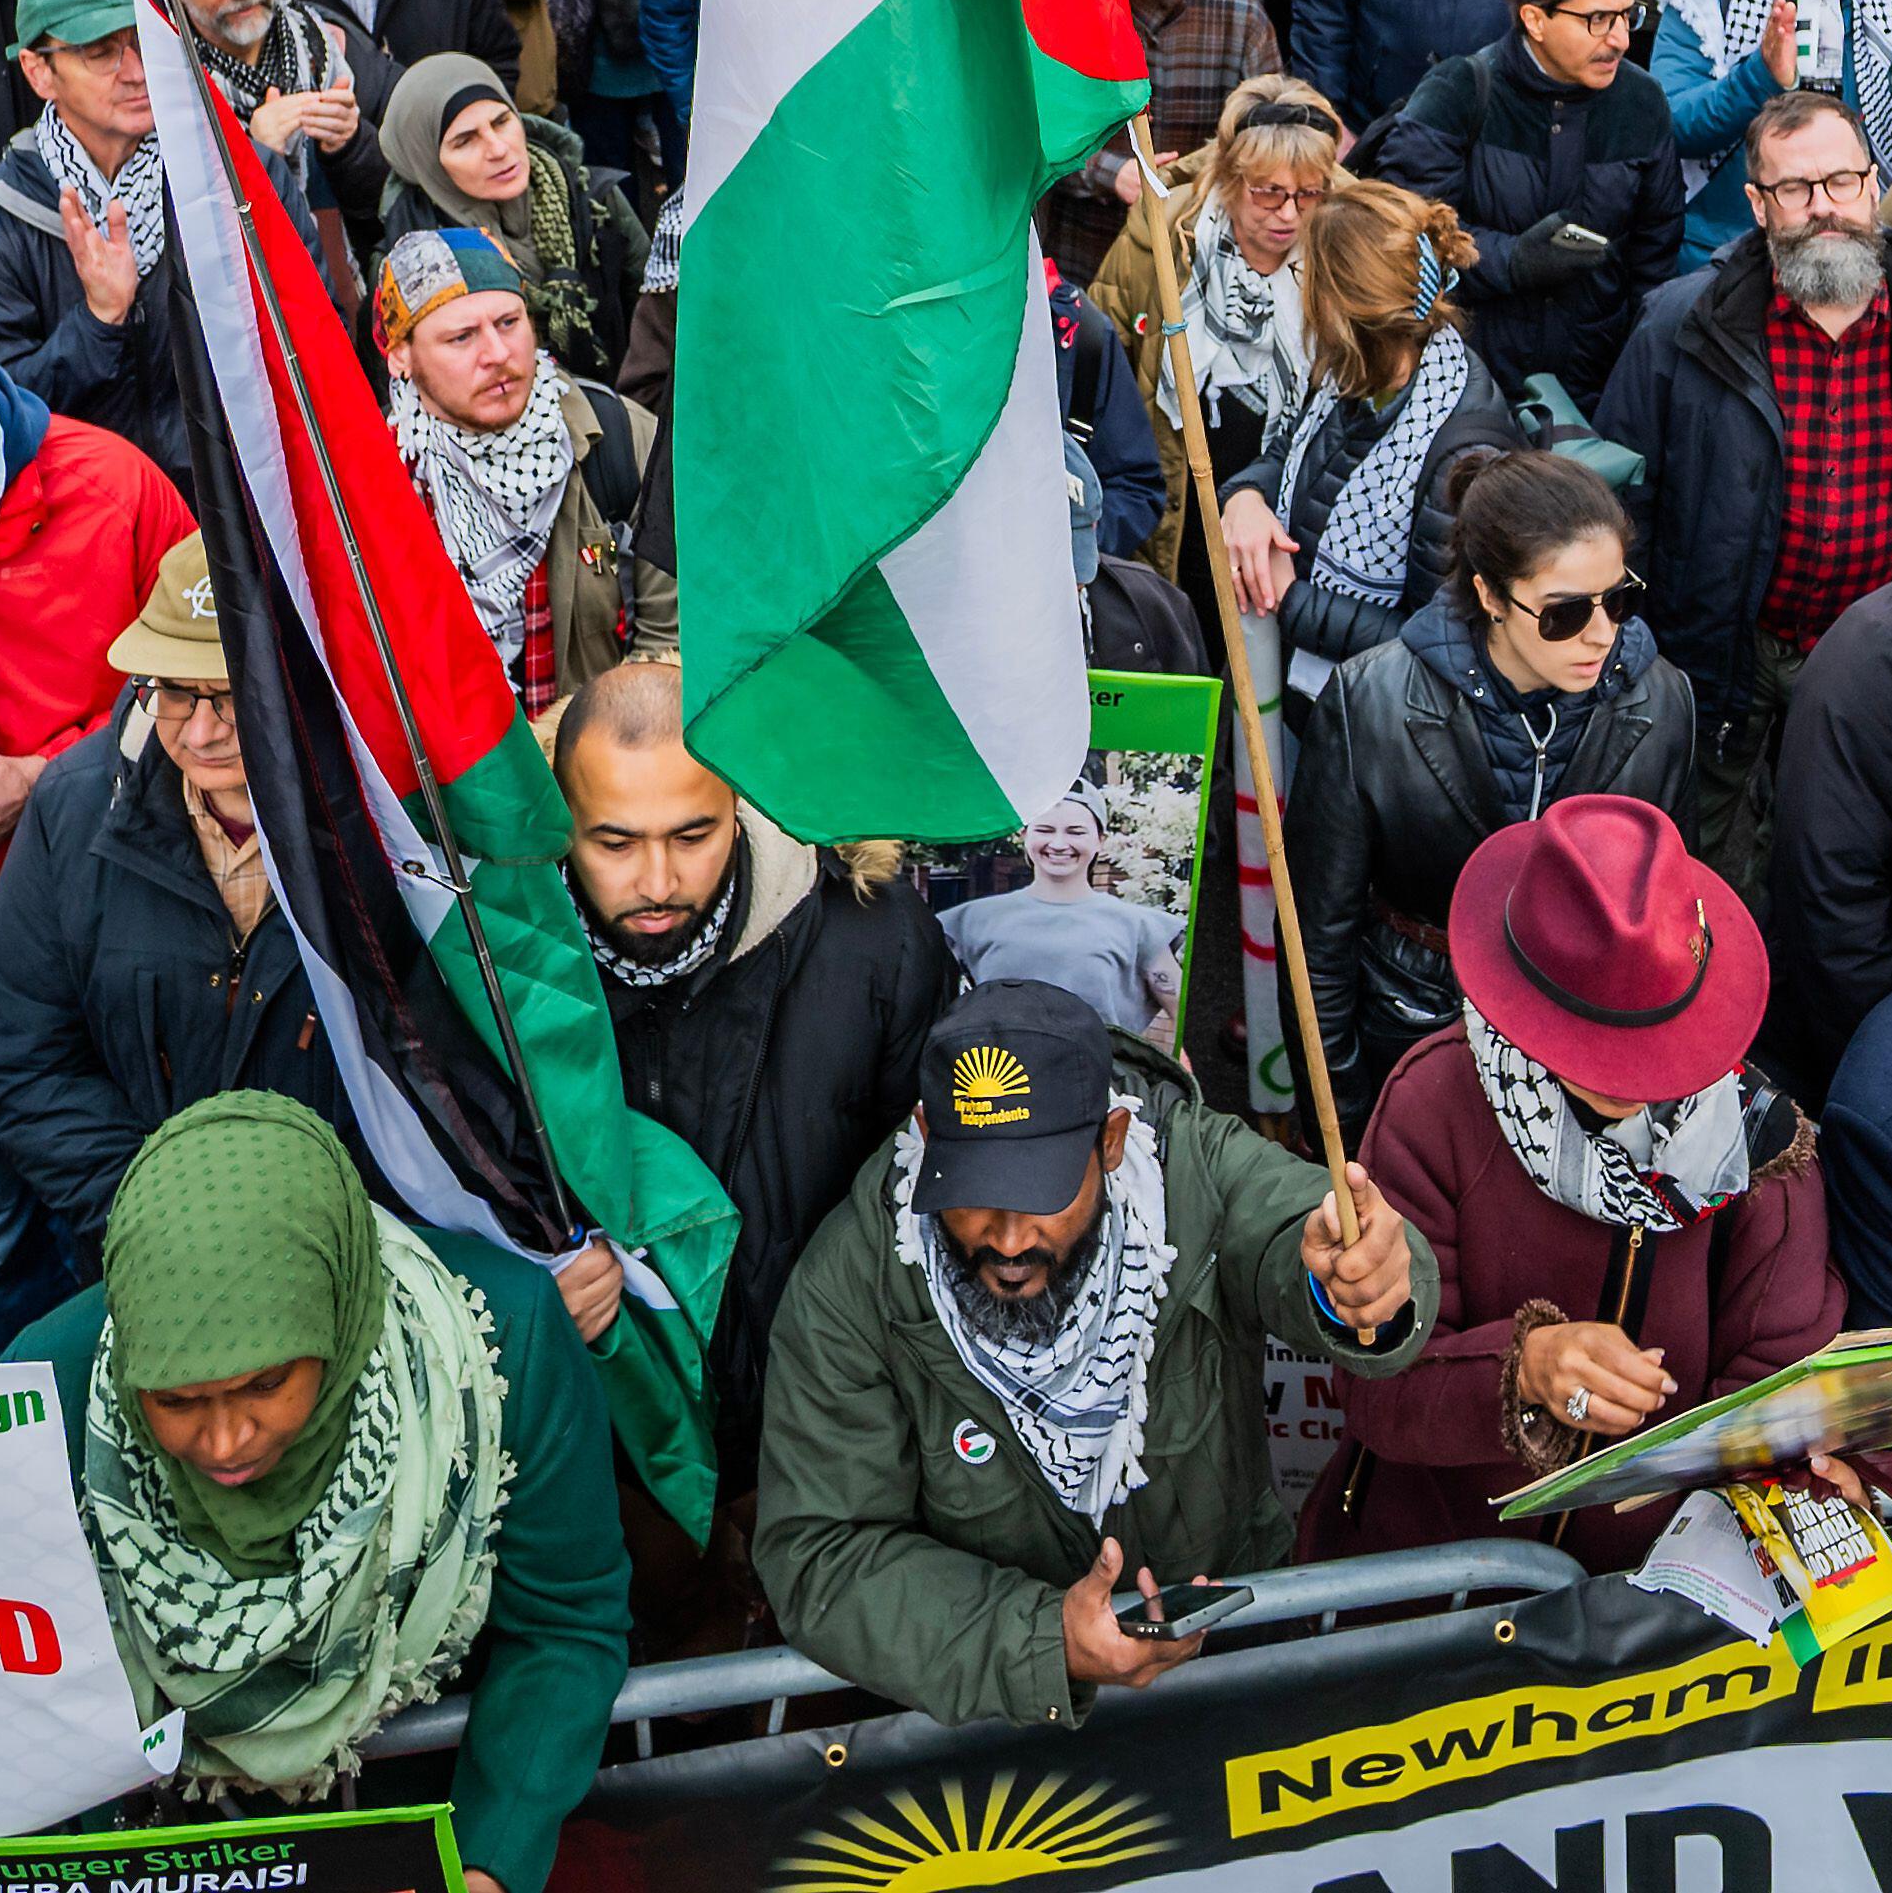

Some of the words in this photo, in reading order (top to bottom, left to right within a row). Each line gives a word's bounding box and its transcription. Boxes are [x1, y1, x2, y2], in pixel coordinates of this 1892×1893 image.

[960, 1106, 1031, 1128] Independents
[1831, 1530, 1877, 1569] KICK
[1260, 1663, 1772, 1814] Newham
[144, 1839, 297, 1873] Striker
[110, 1862, 309, 1893] MURAISI
